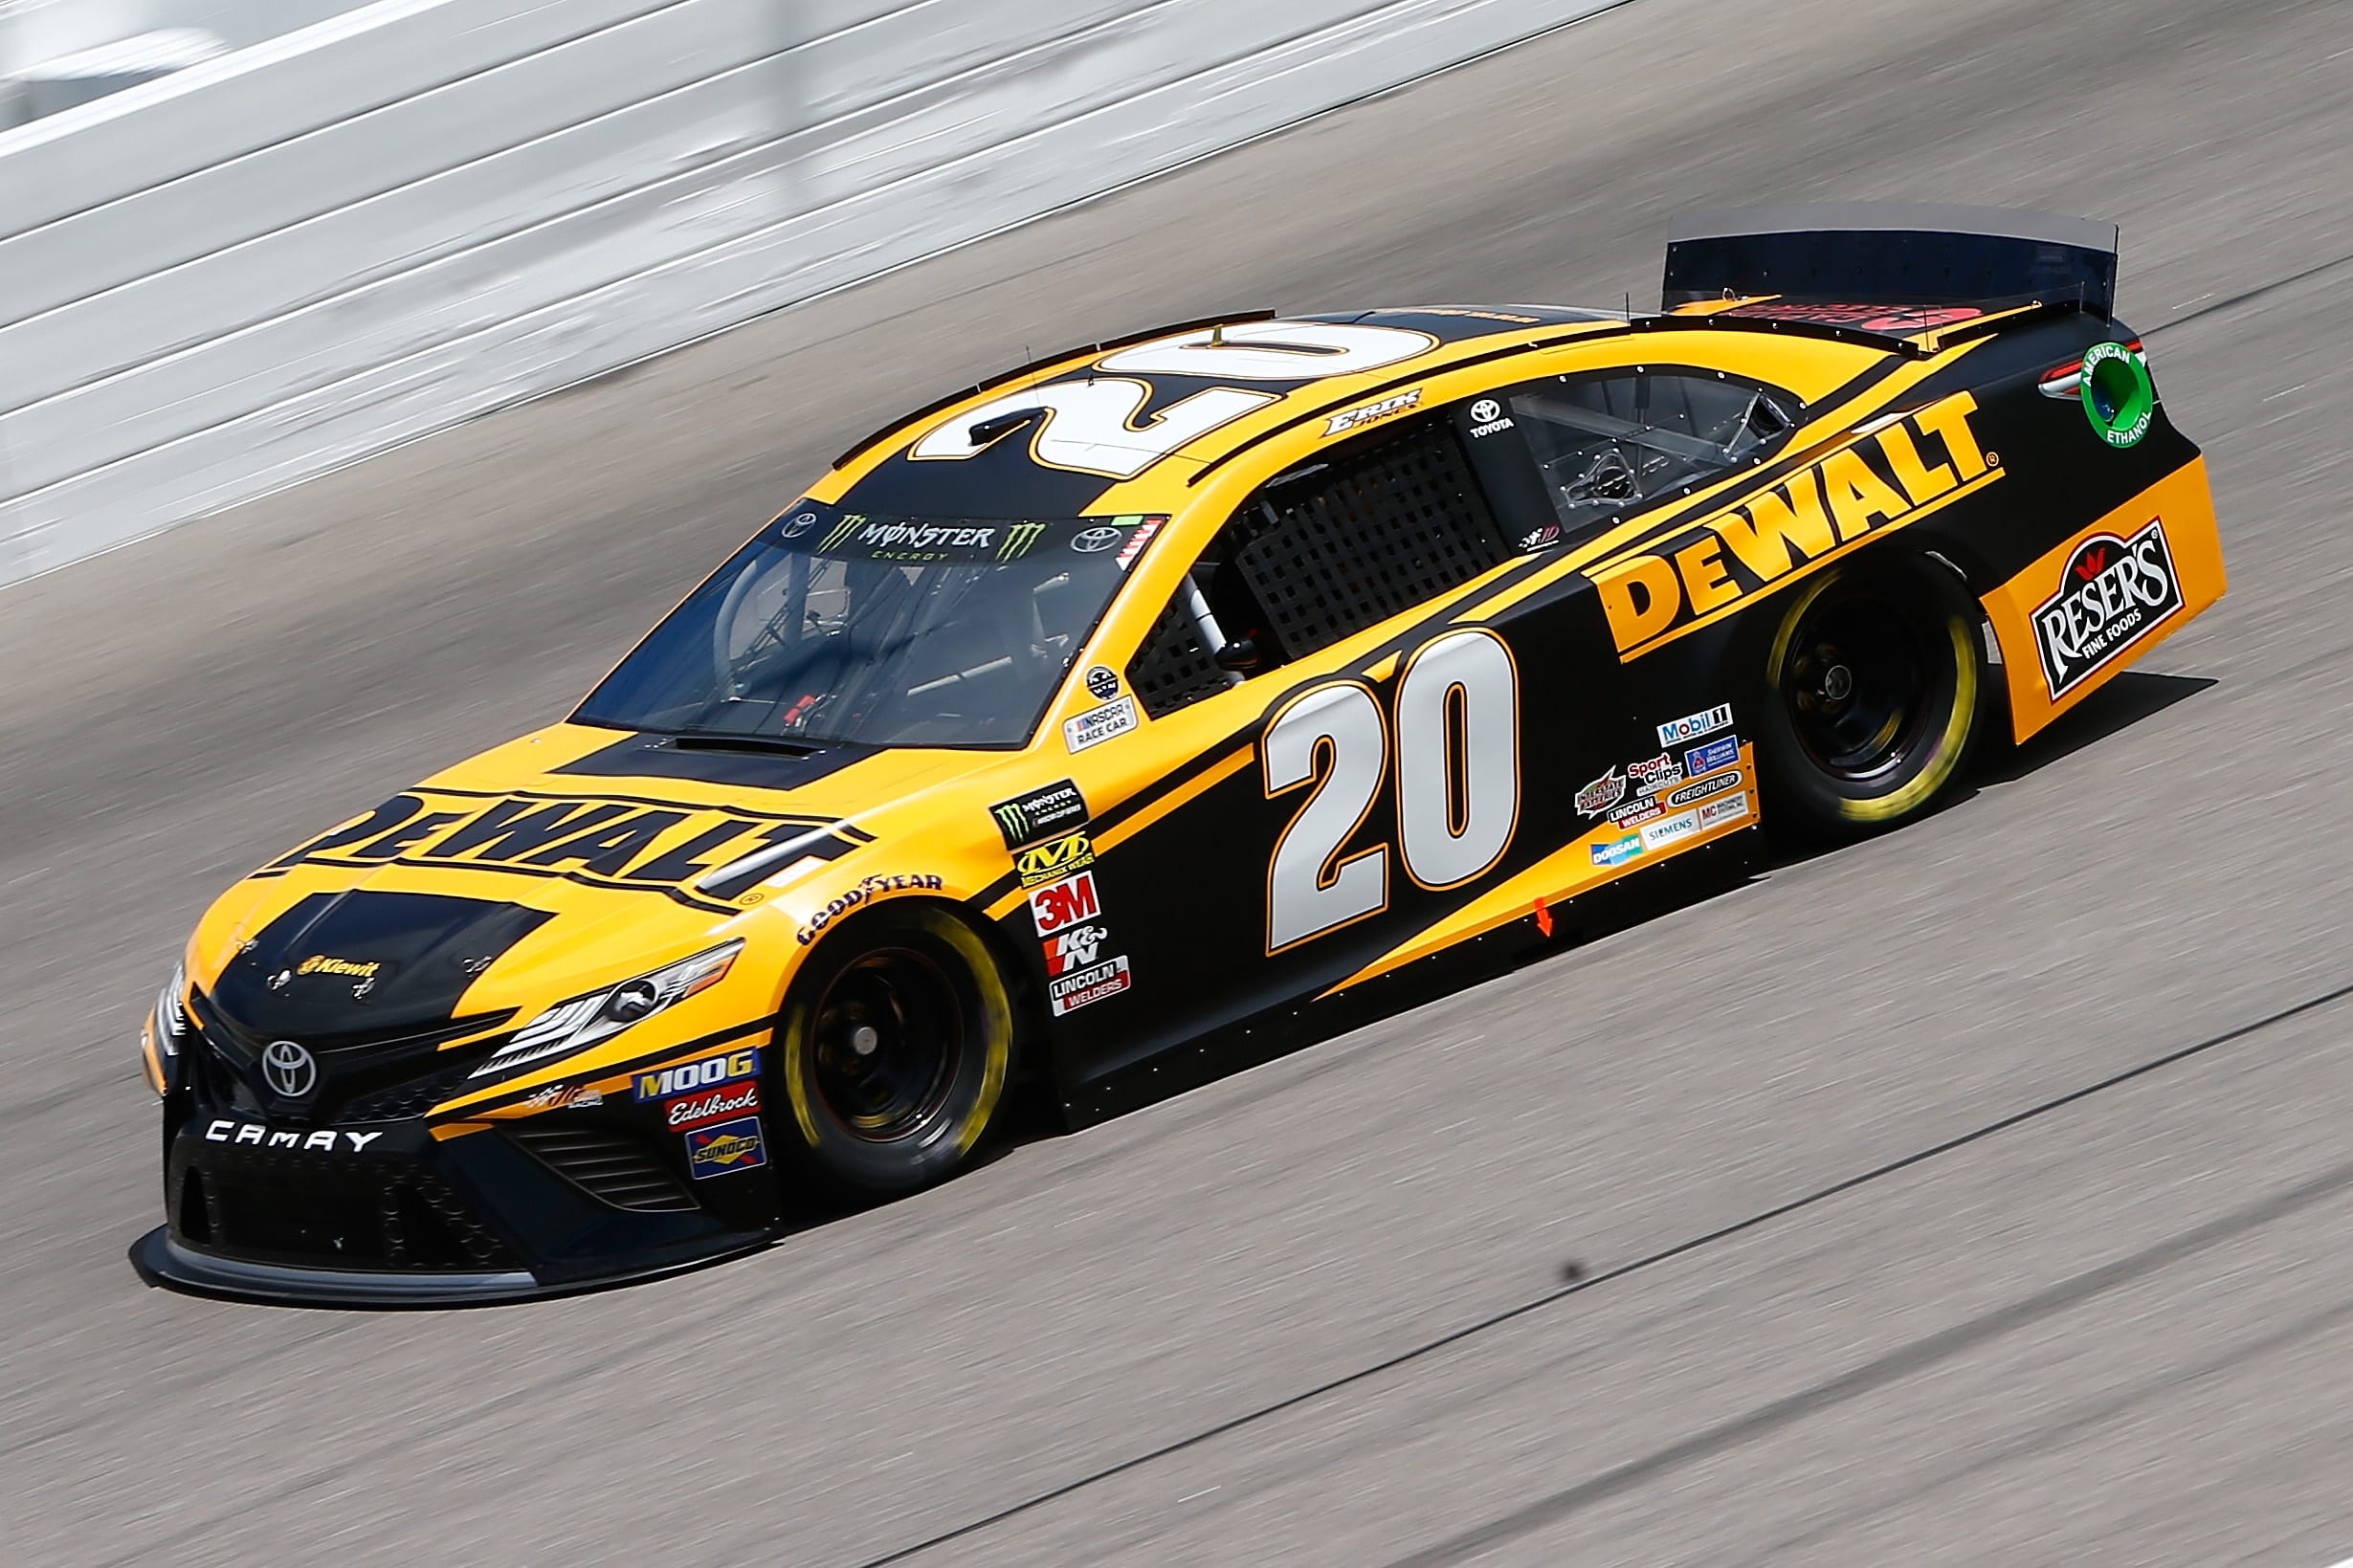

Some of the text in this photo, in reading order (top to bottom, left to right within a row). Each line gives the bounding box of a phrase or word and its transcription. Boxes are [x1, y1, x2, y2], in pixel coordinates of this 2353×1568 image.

[2082, 345, 2131, 387] AMERICAN
[1325, 388, 1423, 436] ERIK
[1470, 418, 1516, 439] TOYOTA
[2106, 411, 2152, 445] ETHANOL
[1589, 390, 1979, 652] DEWALT
[2041, 540, 2168, 685] RESER'S
[2081, 607, 2142, 659] FINE FOODS
[1083, 703, 1126, 727] NASCAR
[1662, 714, 1711, 741] Mobil
[1077, 717, 1127, 745] RACE CAR
[1629, 754, 1670, 777] Sport
[1645, 763, 1681, 784] Clips
[1261, 627, 1521, 957] 20
[1675, 774, 1736, 805] FREIGHTLINER
[1609, 797, 1654, 822] LINCOLN
[1622, 806, 1662, 828] WELDERS
[1650, 818, 1693, 841] SIEMENS
[1593, 837, 1640, 864] DOOSAN
[796, 872, 943, 946] GOODYEAR
[1034, 874, 1098, 931] 3M
[314, 958, 381, 978] Kiewit
[1053, 963, 1115, 998] LINCOLN
[1068, 978, 1123, 1006] WELDERS
[639, 1050, 755, 1099] MOOG
[669, 1088, 759, 1126] Edelbrock
[693, 1136, 760, 1164] SUNOCO
